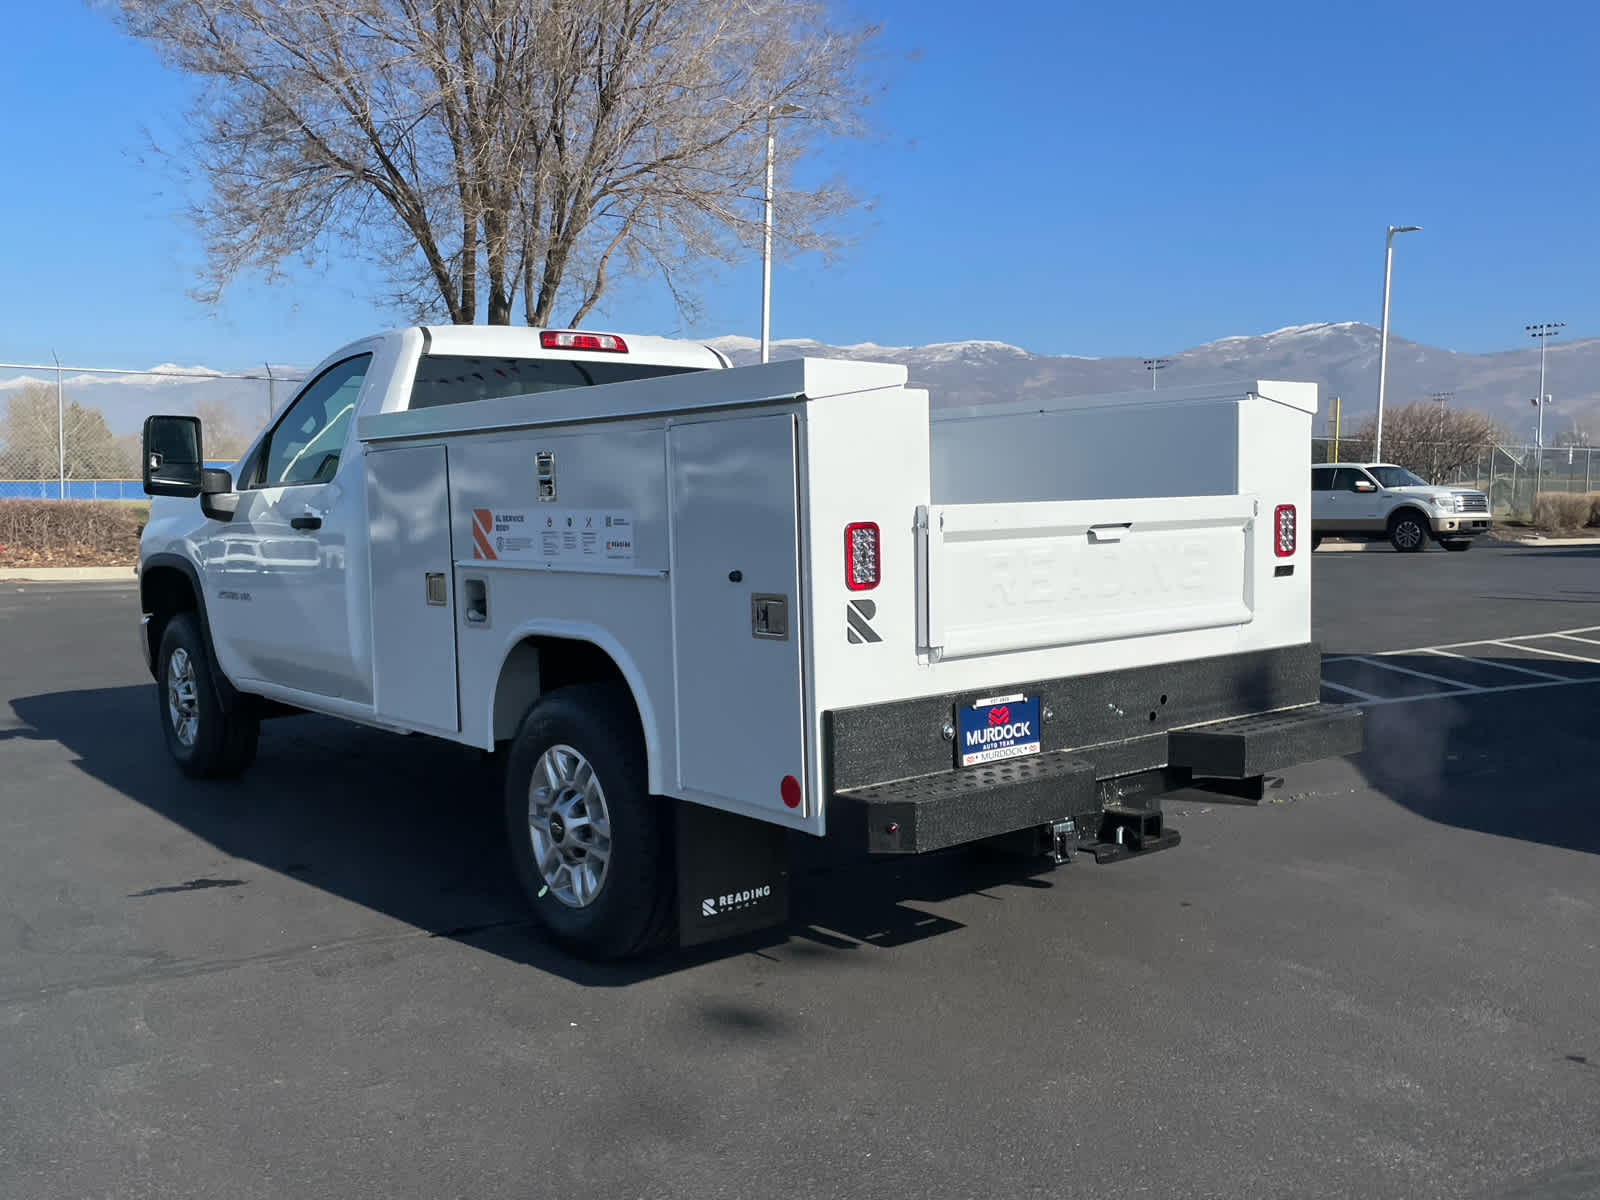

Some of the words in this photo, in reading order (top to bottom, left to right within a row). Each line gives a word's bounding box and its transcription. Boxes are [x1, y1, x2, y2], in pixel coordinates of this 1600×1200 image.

[502, 514, 524, 523] SERVICE
[495, 524, 510, 532] BODY
[966, 721, 1031, 746] MURDOCK
[983, 742, 998, 750] AUTO
[1000, 739, 1015, 748] TEAM
[981, 746, 1023, 760] MURDOCK
[719, 885, 771, 906] READING
